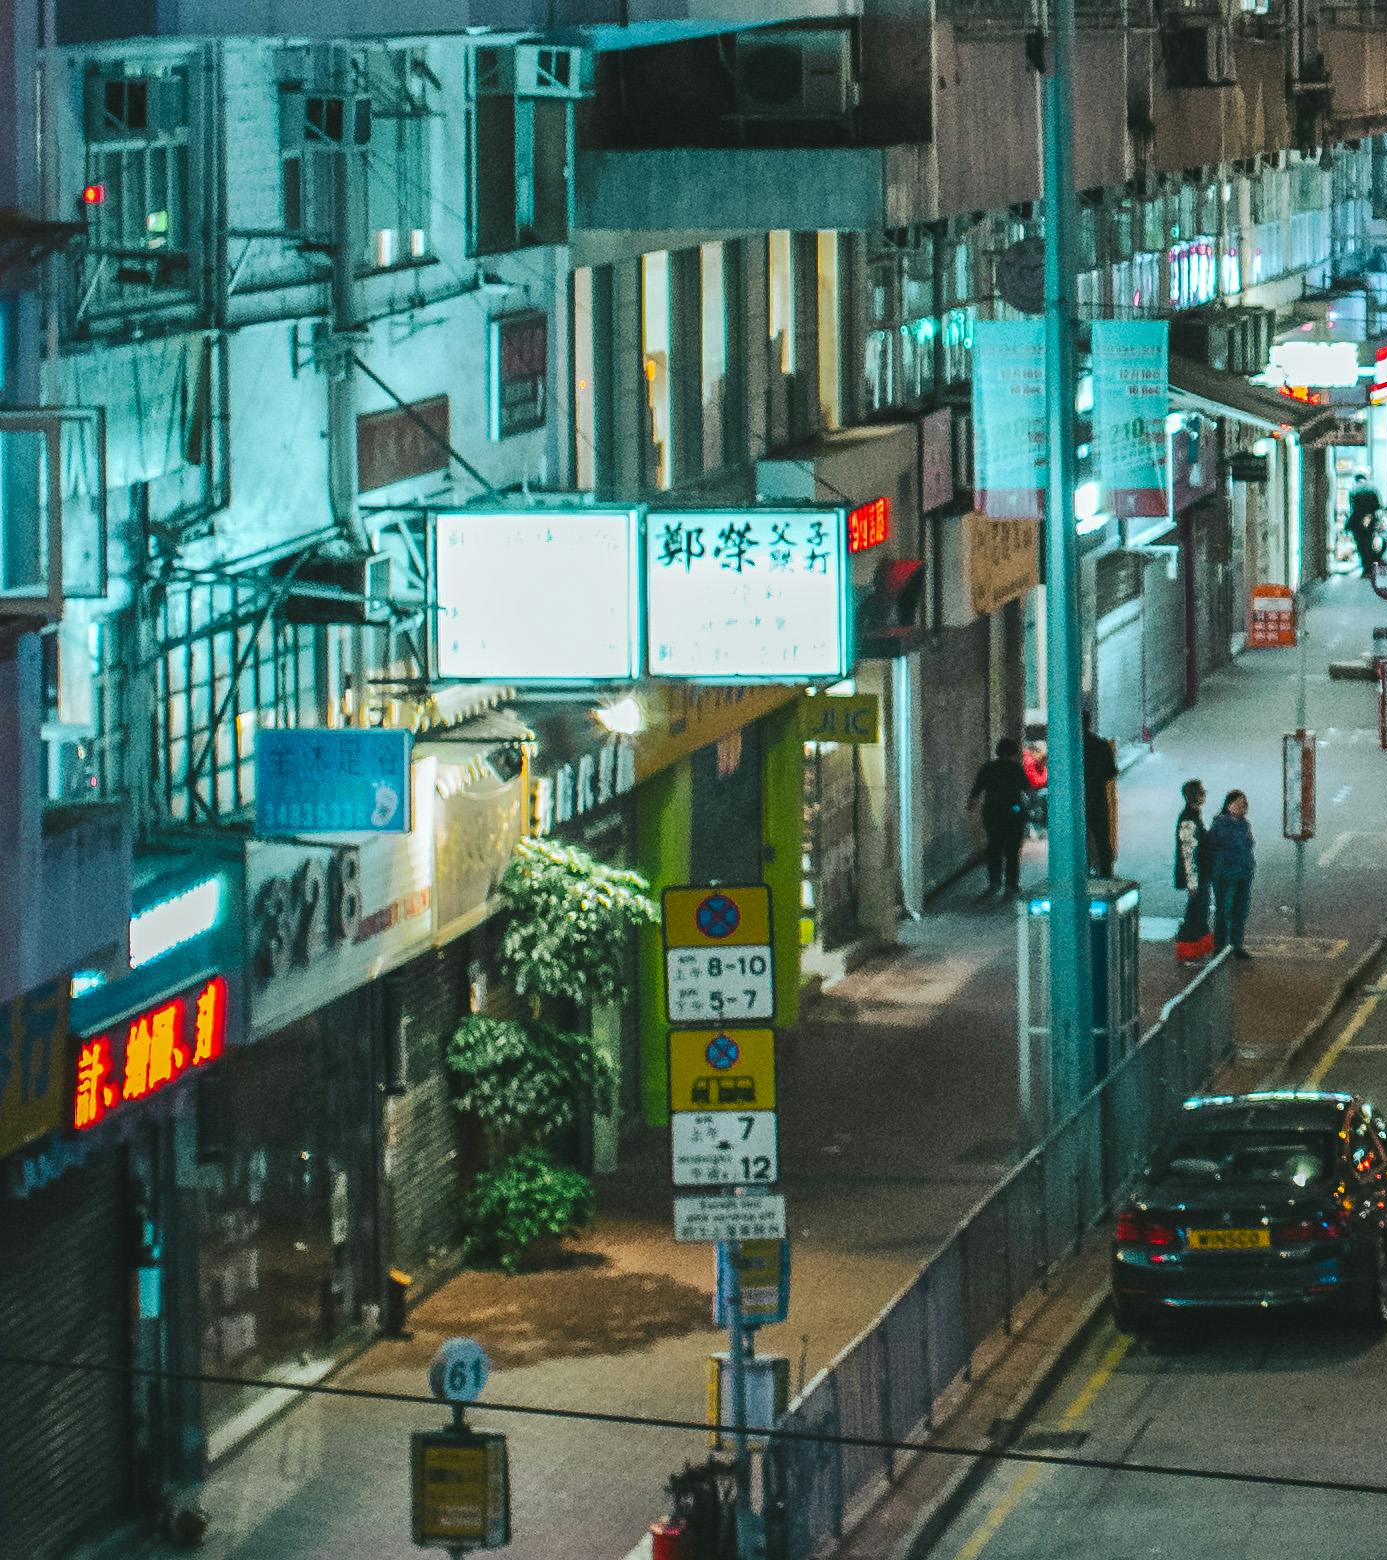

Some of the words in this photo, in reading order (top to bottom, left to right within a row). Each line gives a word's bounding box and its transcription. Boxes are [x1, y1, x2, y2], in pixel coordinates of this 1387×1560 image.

[707, 955, 767, 977] 8-10
[738, 1116, 756, 1140] 7
[740, 1155, 771, 1180] 12
